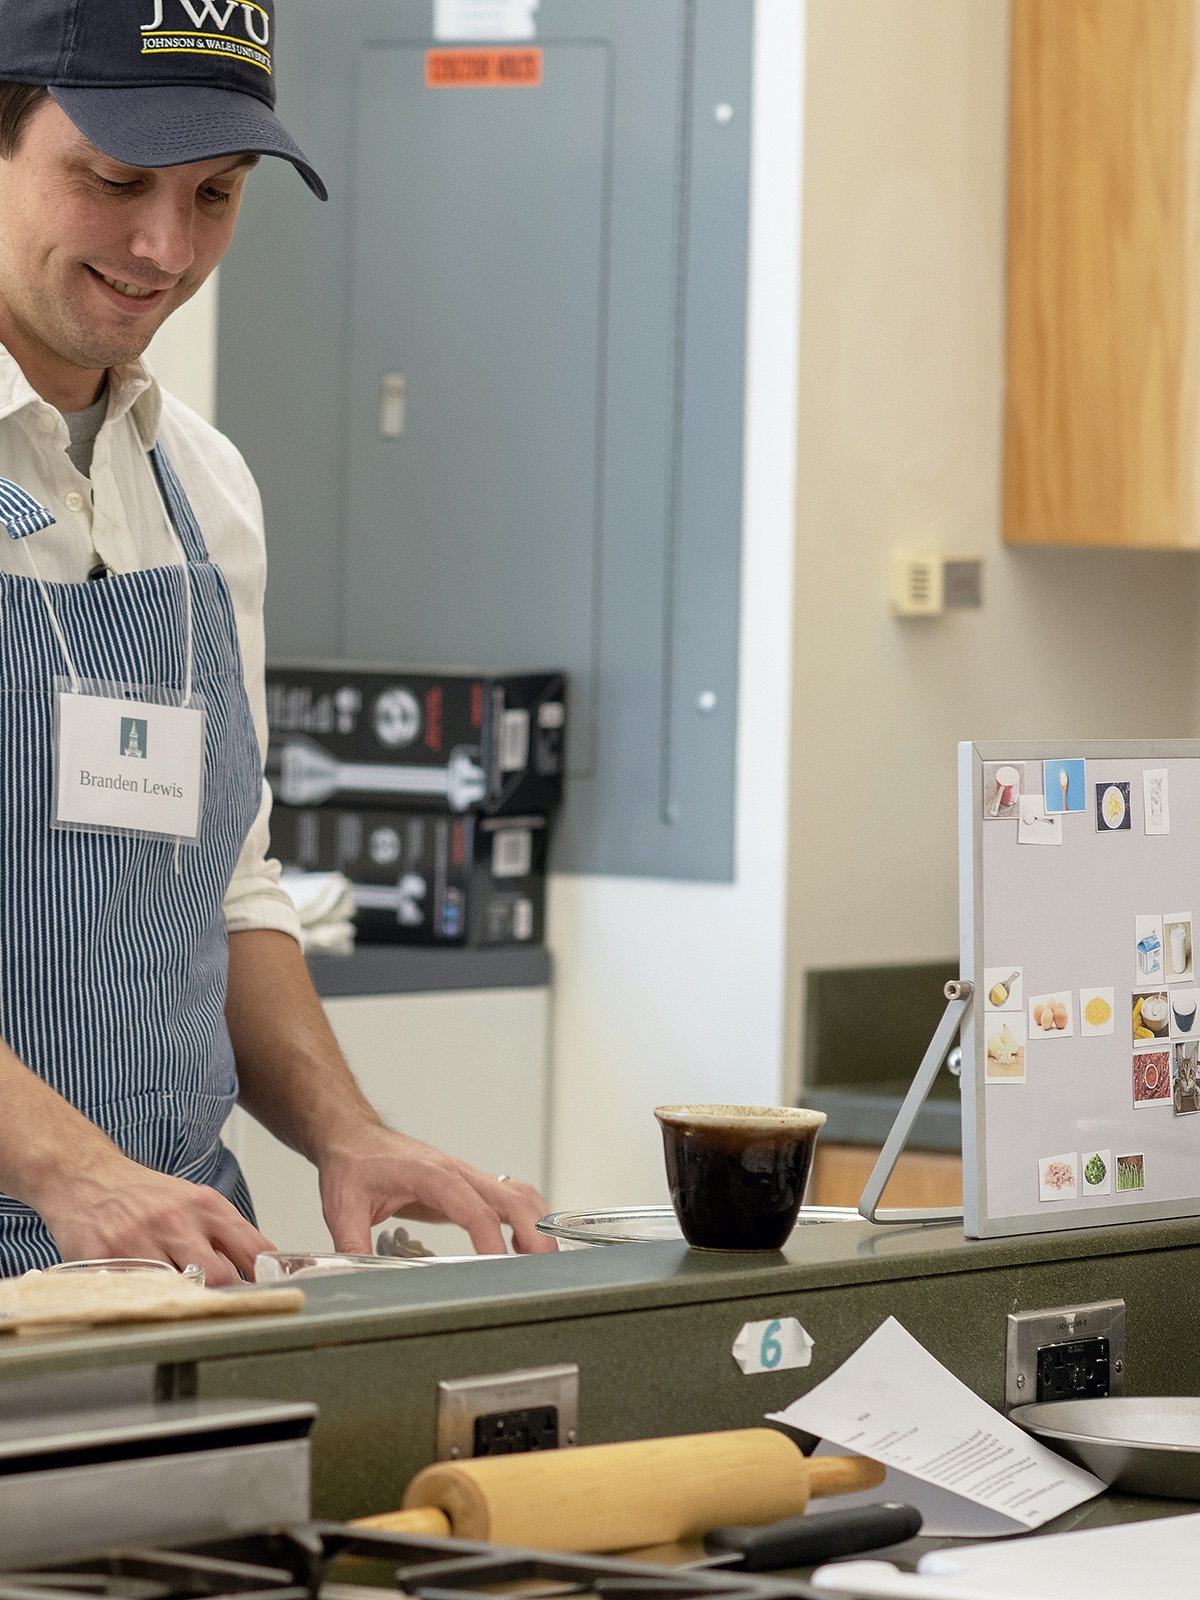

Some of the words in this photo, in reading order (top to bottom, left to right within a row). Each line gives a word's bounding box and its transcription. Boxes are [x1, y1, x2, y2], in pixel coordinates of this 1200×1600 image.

[143, 38, 195, 50] JOHNSON
[197, 40, 205, 48] &
[206, 40, 236, 53] WALES
[80, 770, 138, 792] Branden
[142, 778, 184, 798] Lewis
[761, 1318, 782, 1369] 6
